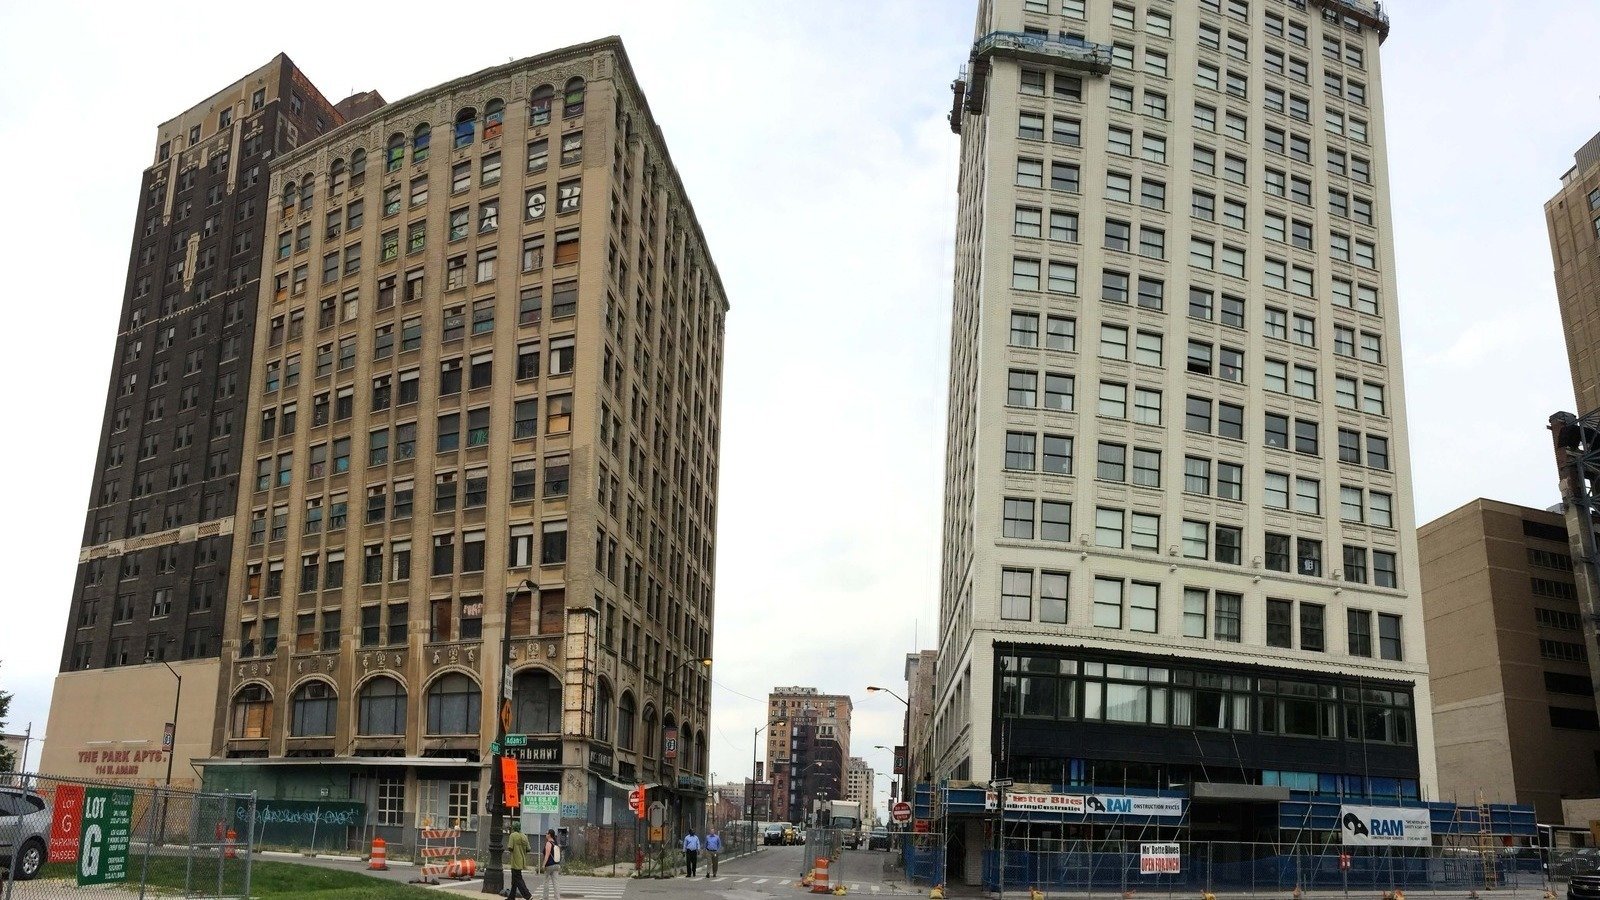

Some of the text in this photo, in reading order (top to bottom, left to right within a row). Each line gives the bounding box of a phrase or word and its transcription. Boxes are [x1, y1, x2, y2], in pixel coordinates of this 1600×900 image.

[78, 751, 98, 763] THE
[102, 751, 130, 762] PARK
[115, 766, 139, 774] ADAMS
[62, 800, 75, 808] LOT
[85, 796, 106, 819] LOT
[62, 814, 72, 832] G
[1371, 819, 1404, 836] RAM
[51, 838, 79, 847] PARKING
[51, 850, 76, 860] PASSES
[81, 824, 102, 877] G
